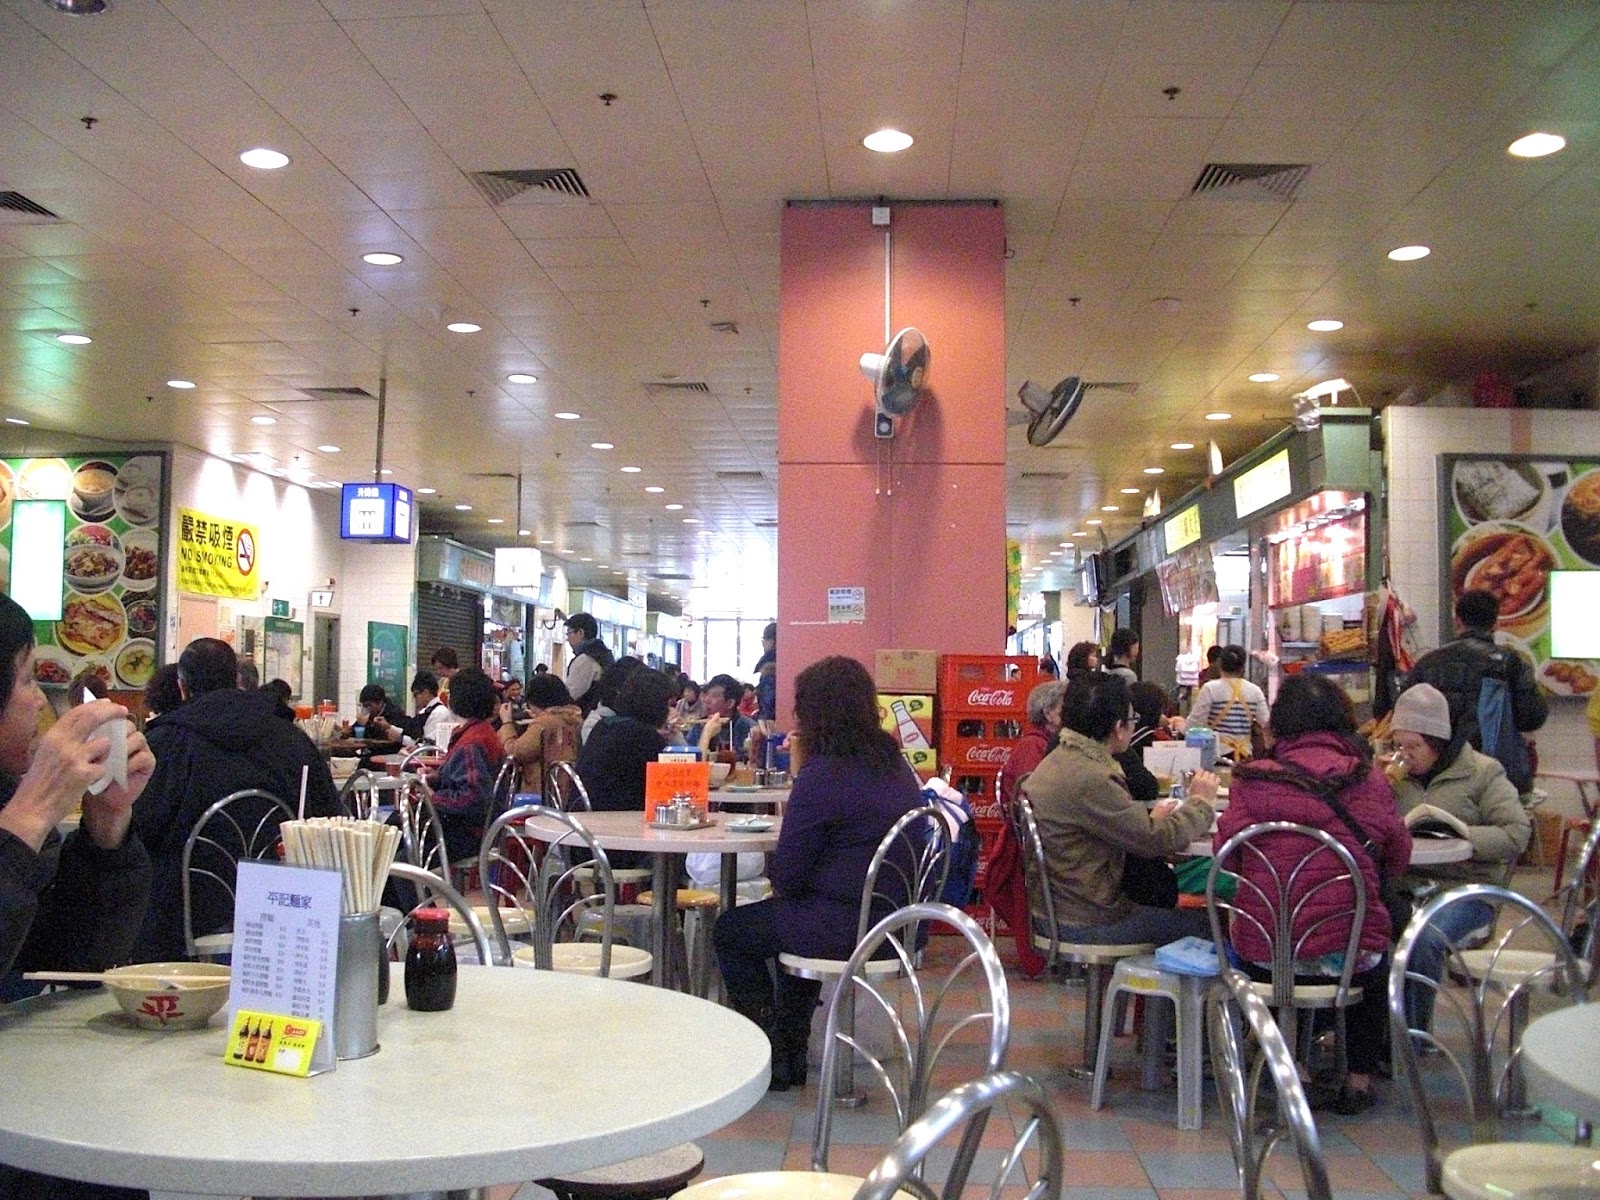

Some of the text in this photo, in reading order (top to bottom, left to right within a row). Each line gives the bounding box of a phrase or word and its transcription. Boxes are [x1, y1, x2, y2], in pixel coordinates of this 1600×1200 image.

[181, 514, 234, 551] 嚴禁吸煙
[181, 547, 233, 569] NO SMOKING
